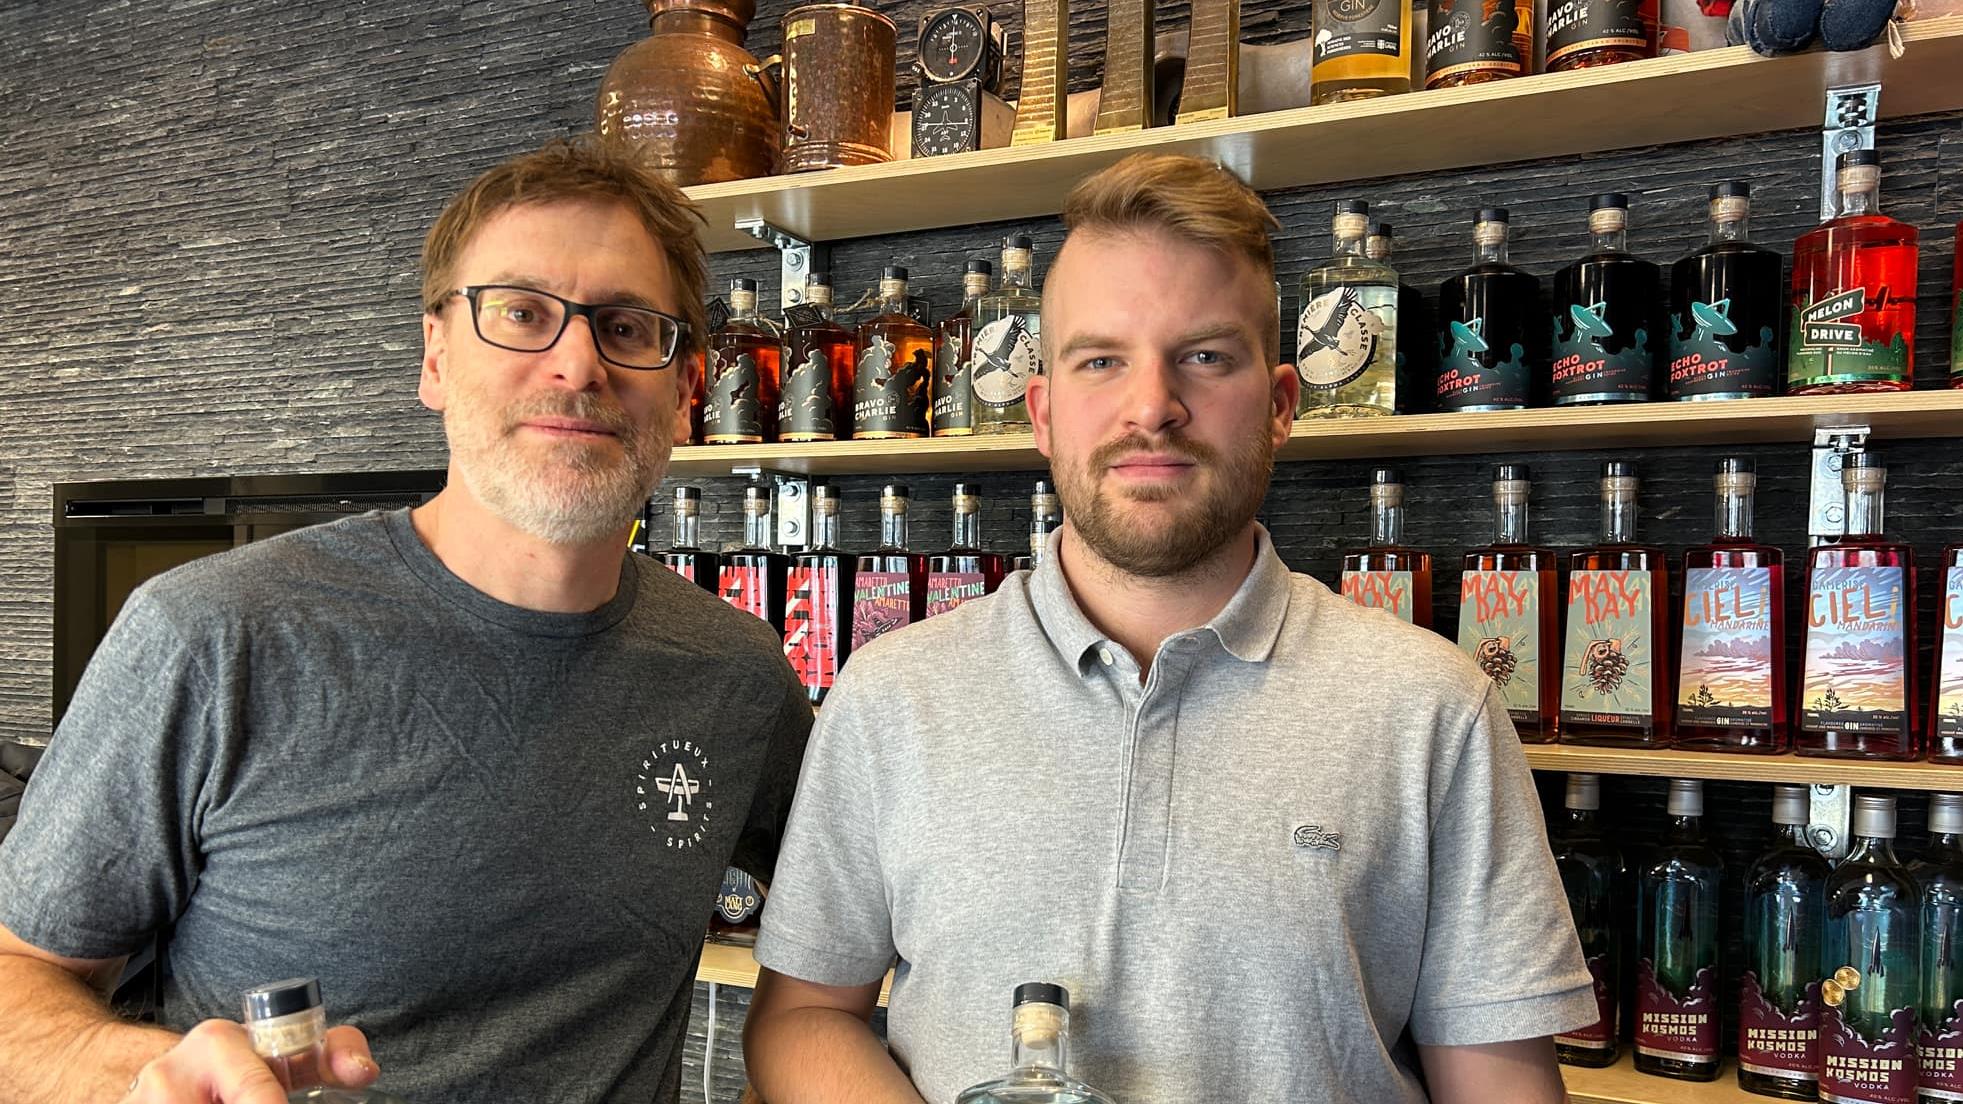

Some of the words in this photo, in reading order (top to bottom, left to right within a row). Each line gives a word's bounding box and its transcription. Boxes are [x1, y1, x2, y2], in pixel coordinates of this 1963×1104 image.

[1340, 0, 1366, 12] GIN
[1548, 1, 1573, 26] RAVO
[1548, 6, 1589, 37] HARLIE
[1427, 25, 1452, 48] RAVO
[1427, 31, 1466, 59] HARLIE
[1808, 298, 1854, 322] MELON
[1350, 308, 1369, 350] CLASSE
[1811, 328, 1854, 341] DRIVE
[1020, 334, 1036, 373] CLASSE
[1671, 353, 1701, 372] ECHO
[1552, 360, 1605, 383] FOXTROT
[1585, 372, 1603, 381] GIN
[1671, 359, 1728, 383] FOXTROT
[1707, 371, 1726, 380] GIN
[1463, 385, 1479, 393] GIN
[855, 398, 885, 412] BRAVO
[855, 406, 896, 420] CHARLIE
[854, 581, 910, 601] VALENTINE
[927, 581, 985, 603] VALENTINE
[1461, 571, 1519, 605] MAY
[1569, 571, 1629, 606] MAY
[1477, 588, 1529, 624] DAY
[1585, 588, 1641, 624] DAY
[1710, 620, 1769, 631] MANDARINE
[1591, 714, 1620, 724] LIQUEUR
[1716, 717, 1730, 725] GIN
[1844, 722, 1859, 730] GIN
[637, 740, 709, 811] SPIRITUEUX
[666, 801, 712, 849] SPIRITS
[1643, 1013, 1708, 1024] MISSION
[1642, 1024, 1697, 1035] KOSMOS
[1747, 1028, 1817, 1040] MISSION
[1747, 1040, 1806, 1052] KOSMOS
[1920, 1047, 1963, 1059] SSIO
[1827, 1055, 1903, 1070] MISSION
[1922, 1059, 1956, 1071] MOS
[1826, 1068, 1890, 1083] KOSMOS
[1854, 1082, 1889, 1090] VODKA
